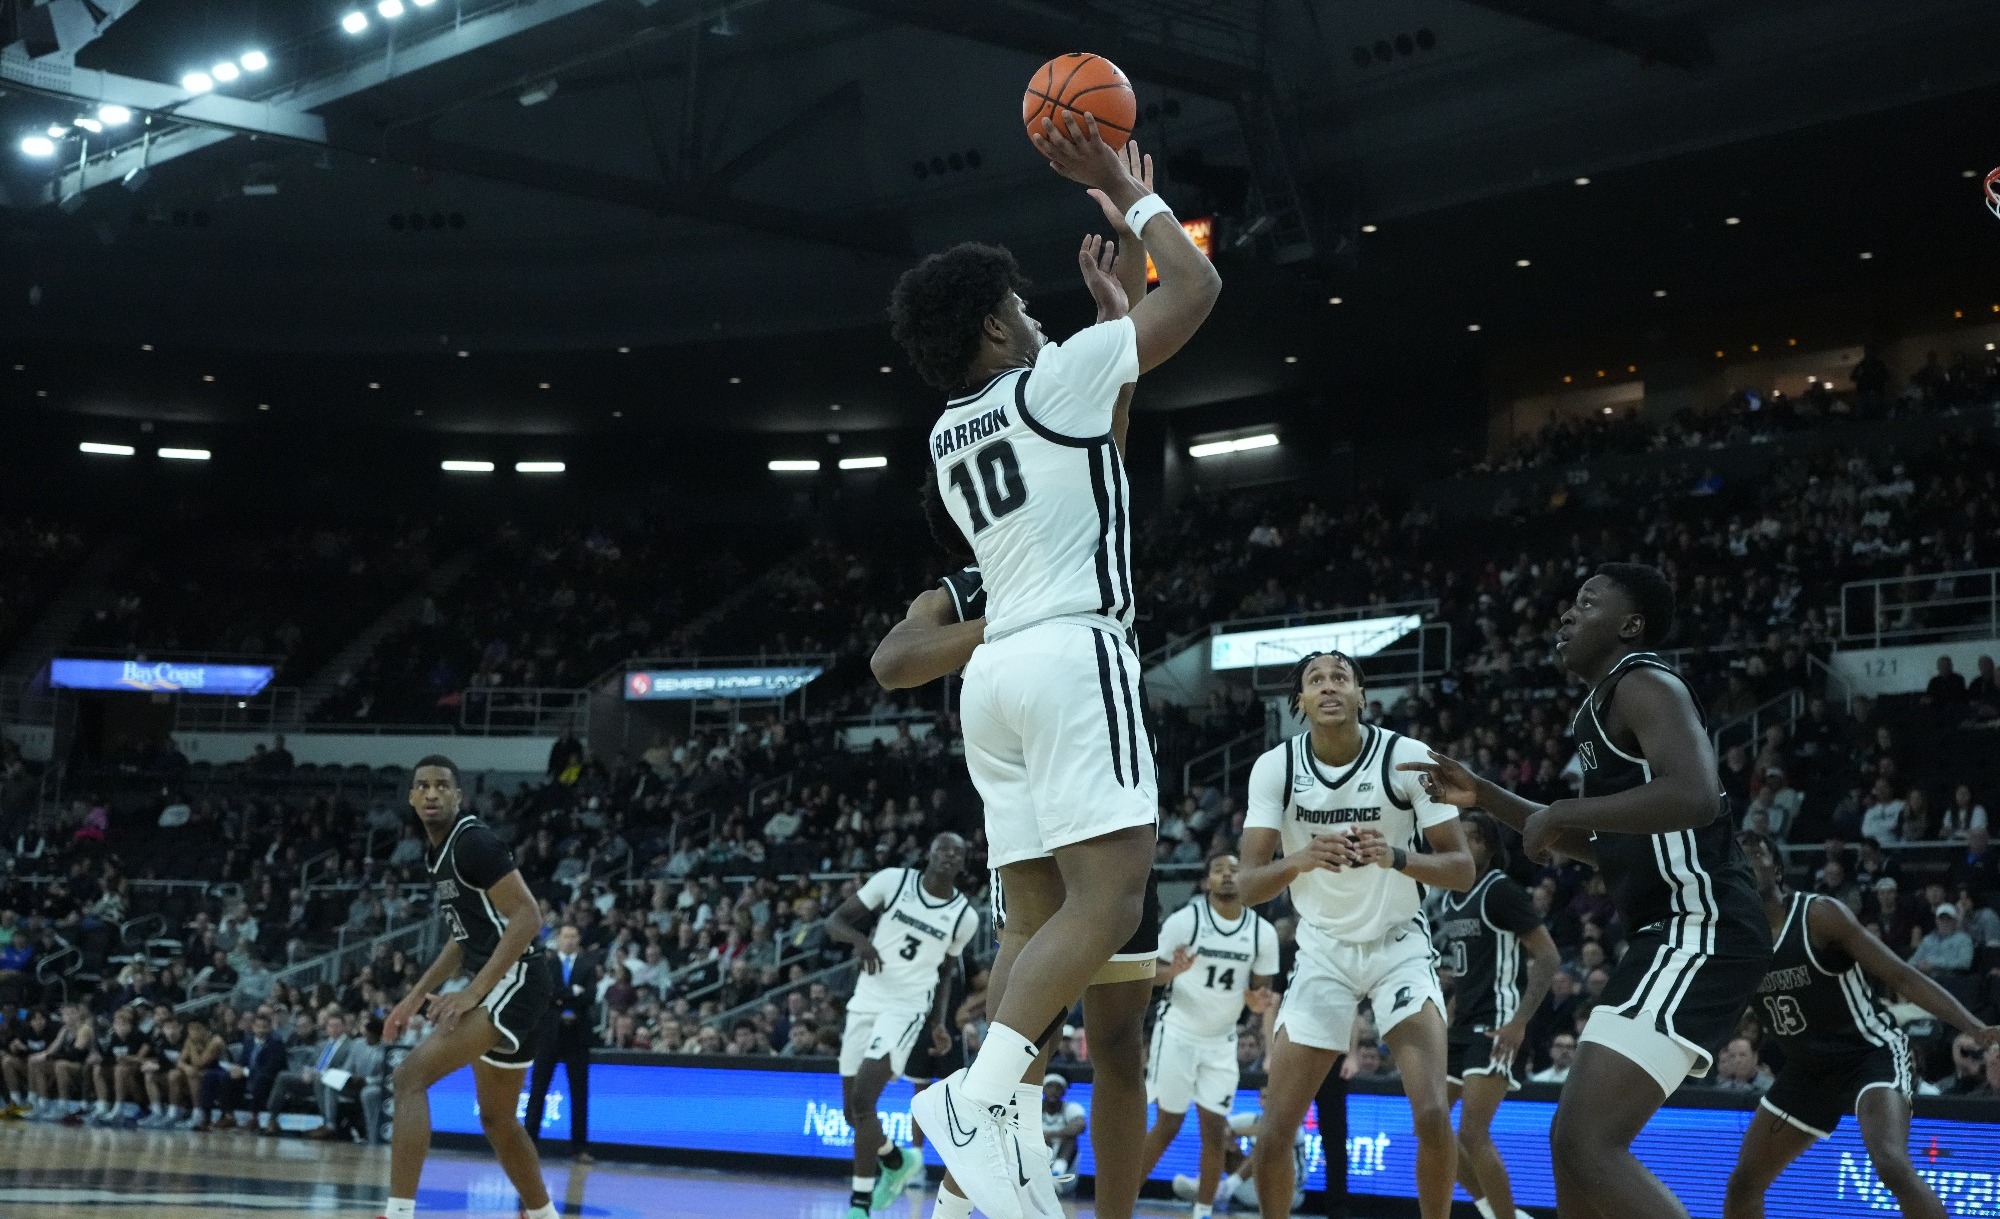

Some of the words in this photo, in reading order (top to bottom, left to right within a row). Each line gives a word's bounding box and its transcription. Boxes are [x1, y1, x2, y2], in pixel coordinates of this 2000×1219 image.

[935, 405, 1011, 460] BARRON
[949, 438, 1029, 537] 10
[123, 660, 205, 685] BayCoast
[1864, 657, 1897, 676] 121
[653, 677, 715, 691] SEMPER
[718, 676, 763, 688] HOME
[1295, 804, 1381, 824] PROVIDENCE
[900, 934, 922, 961] 3
[1204, 965, 1235, 991] 14
[1757, 964, 1811, 993] OWN
[1763, 995, 1807, 1035] 13
